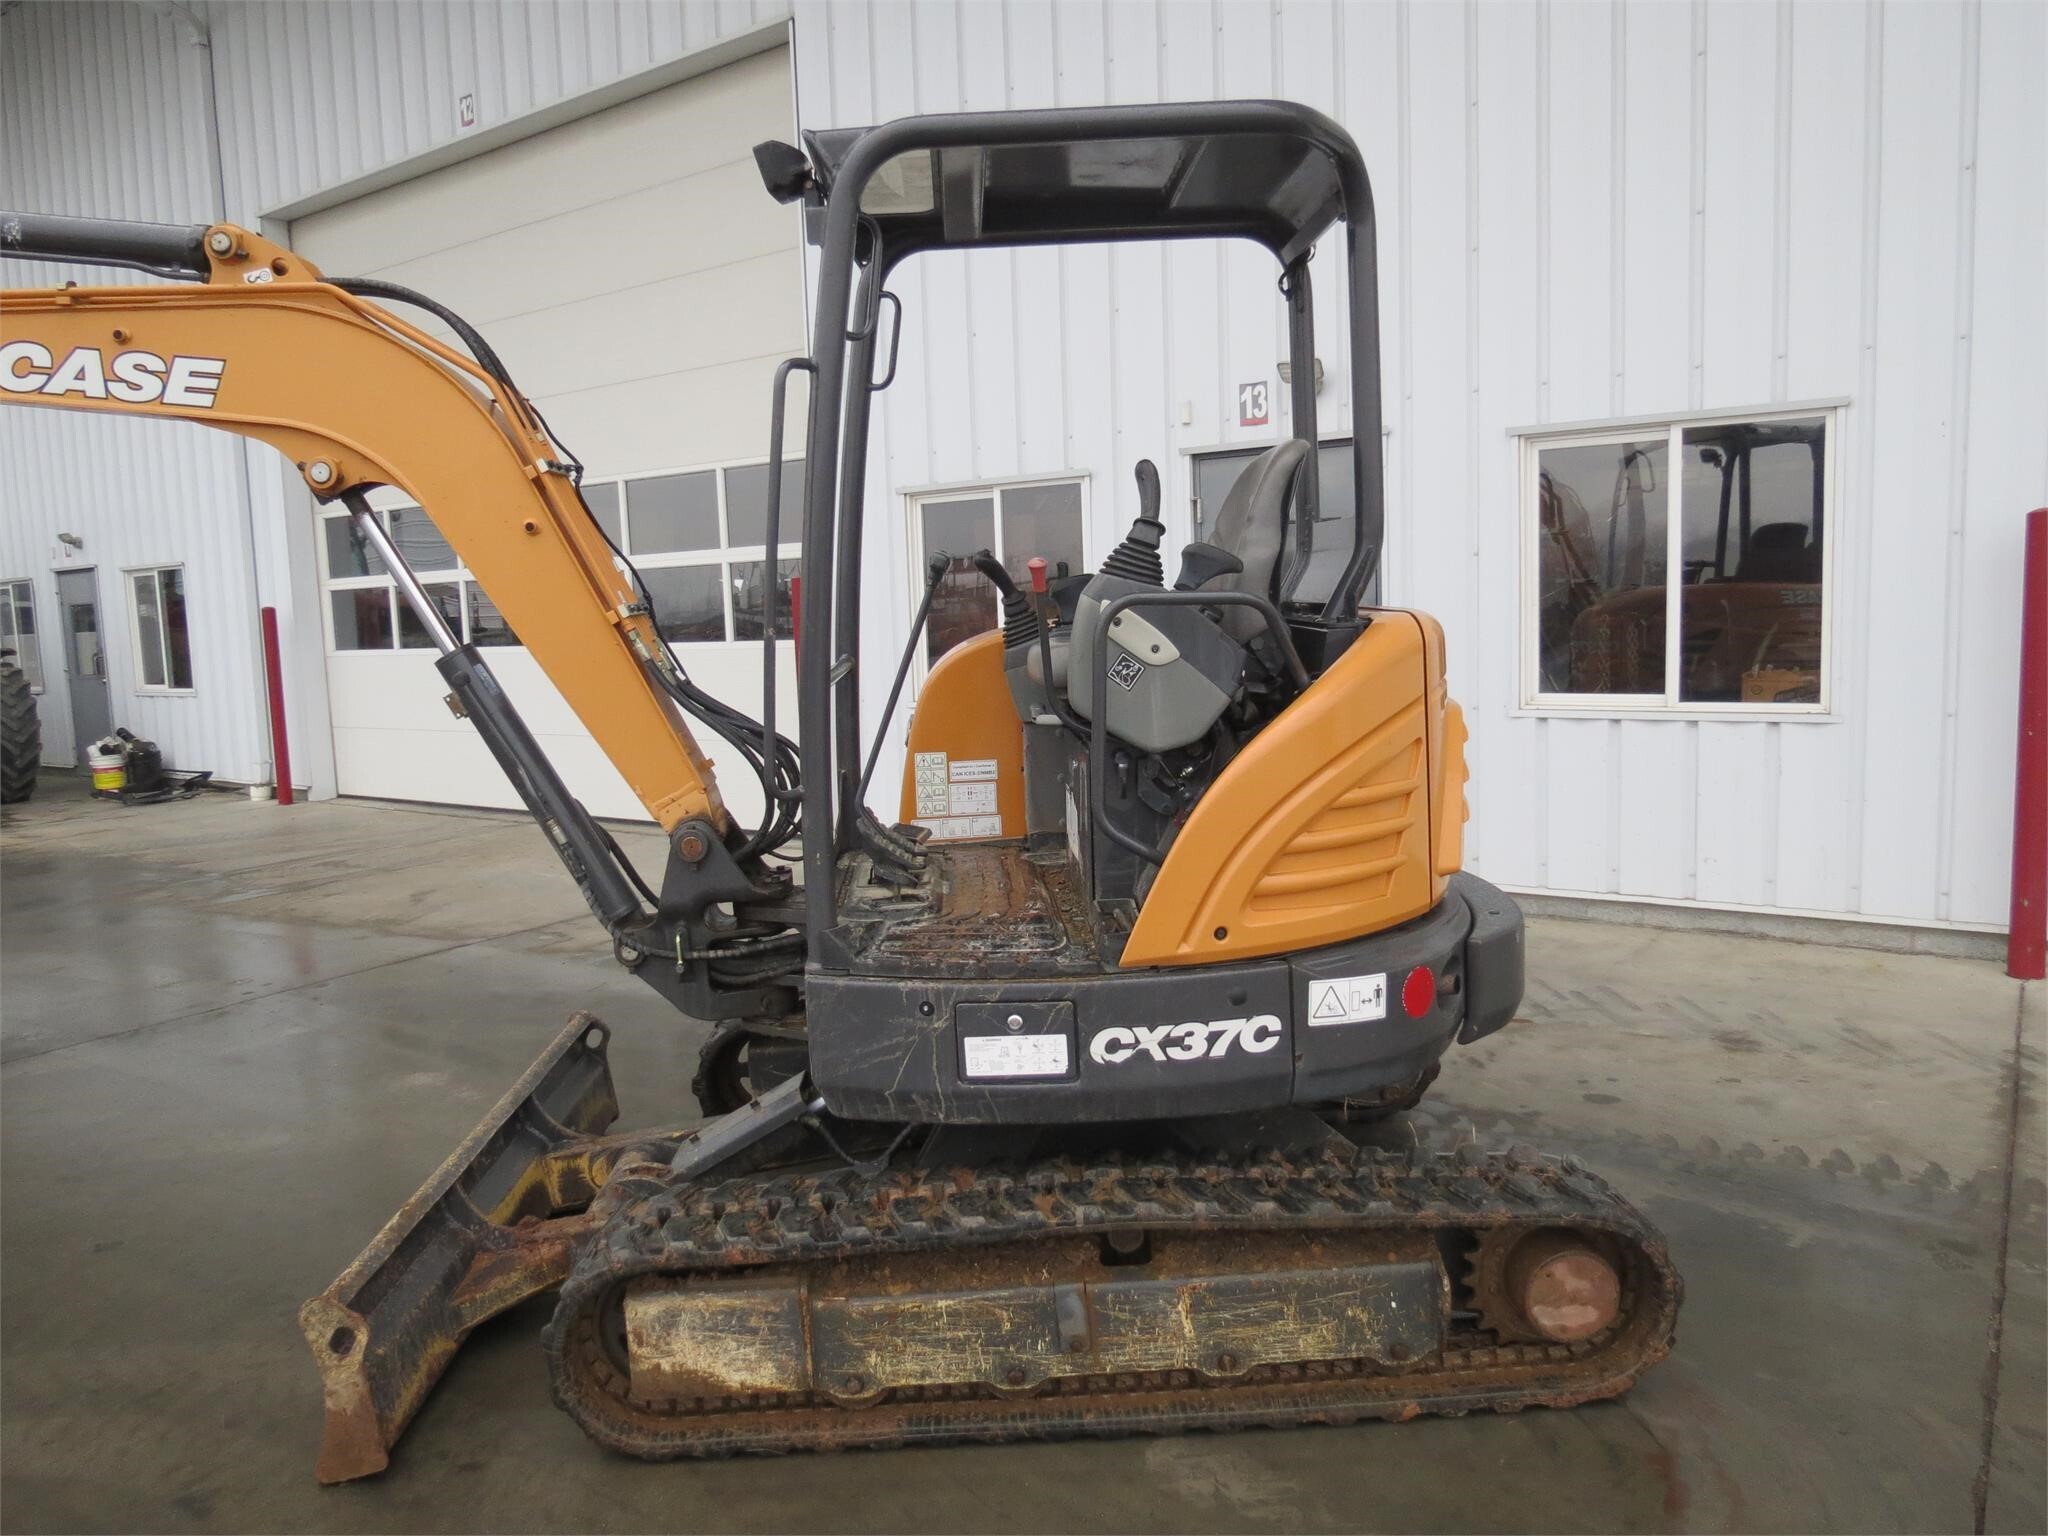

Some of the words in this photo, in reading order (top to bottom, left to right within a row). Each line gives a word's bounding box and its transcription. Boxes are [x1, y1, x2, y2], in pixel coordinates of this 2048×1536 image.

[461, 96, 474, 121] 12
[0, 340, 226, 408] CASE
[1240, 384, 1267, 418] 13
[1089, 1014, 1282, 1065] CX37C
